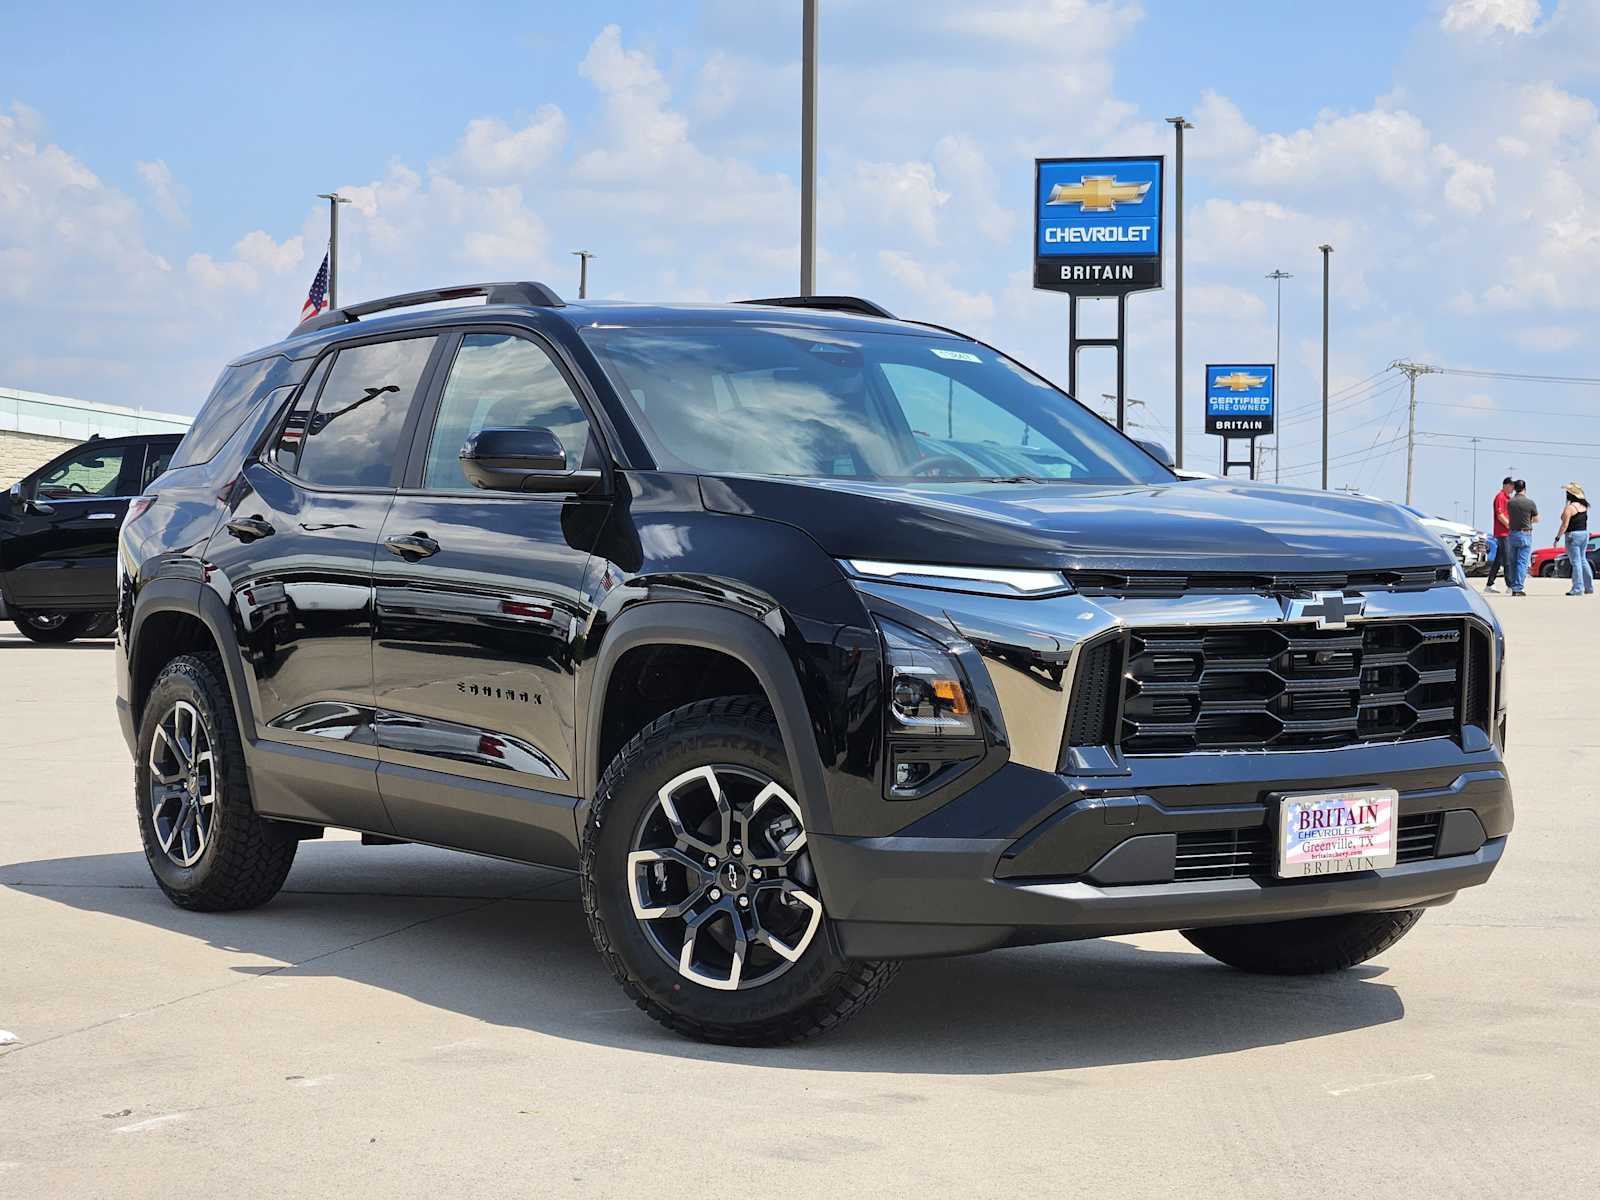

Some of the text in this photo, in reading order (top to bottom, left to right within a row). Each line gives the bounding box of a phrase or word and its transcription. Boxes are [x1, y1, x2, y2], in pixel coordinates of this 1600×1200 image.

[1045, 226, 1151, 242] CHEVROLET
[1060, 265, 1134, 280] BRITAIN
[1215, 421, 1262, 430] BRITAIN
[1299, 804, 1378, 830] BRITAIN
[1298, 827, 1356, 839] CHEVROLET
[1302, 835, 1374, 853] Greenville, TX
[1303, 856, 1375, 875] BRITAIN
